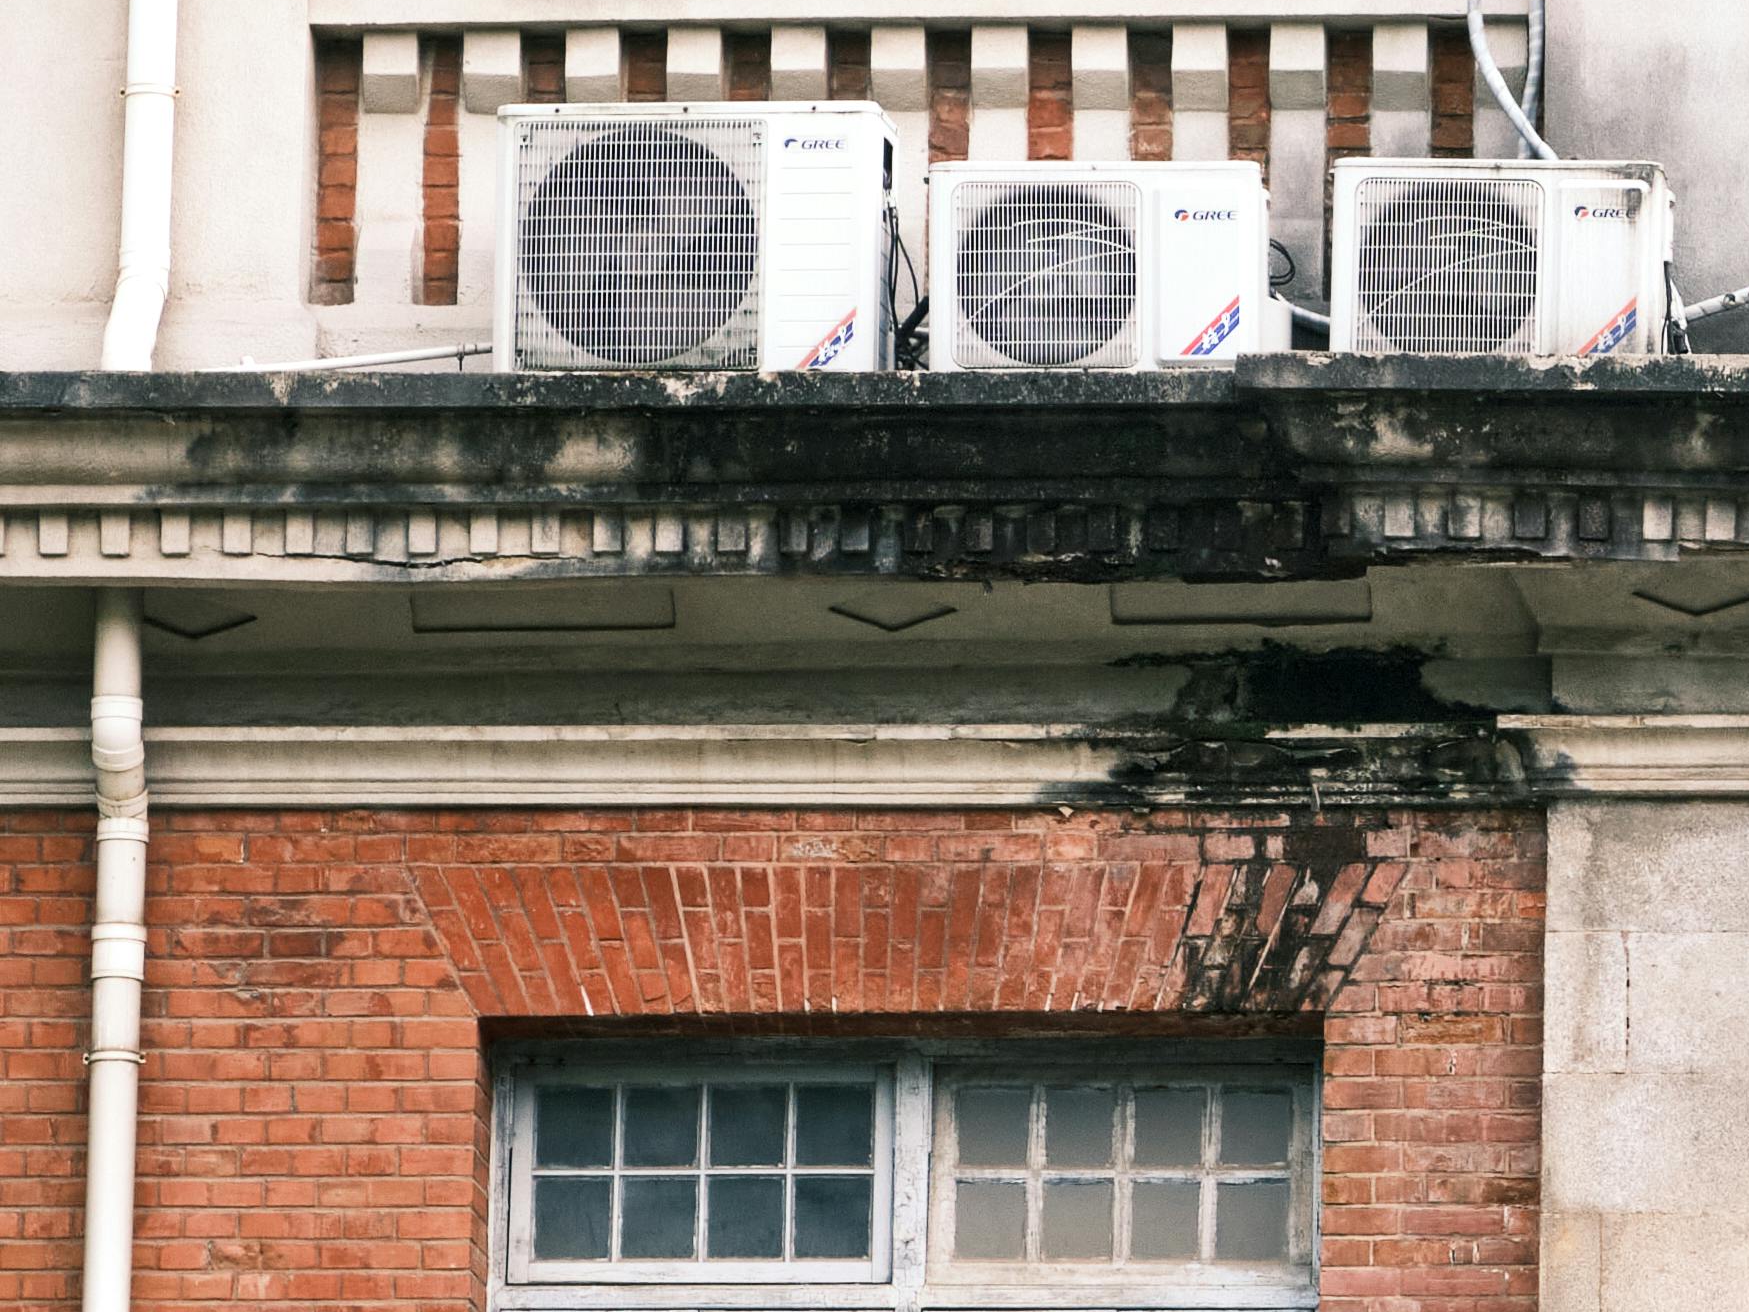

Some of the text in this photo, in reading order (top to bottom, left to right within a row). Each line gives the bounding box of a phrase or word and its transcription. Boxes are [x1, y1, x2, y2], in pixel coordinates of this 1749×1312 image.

[800, 138, 847, 150] GREE
[1192, 209, 1240, 221] GREE
[1591, 207, 1638, 219] GREE
